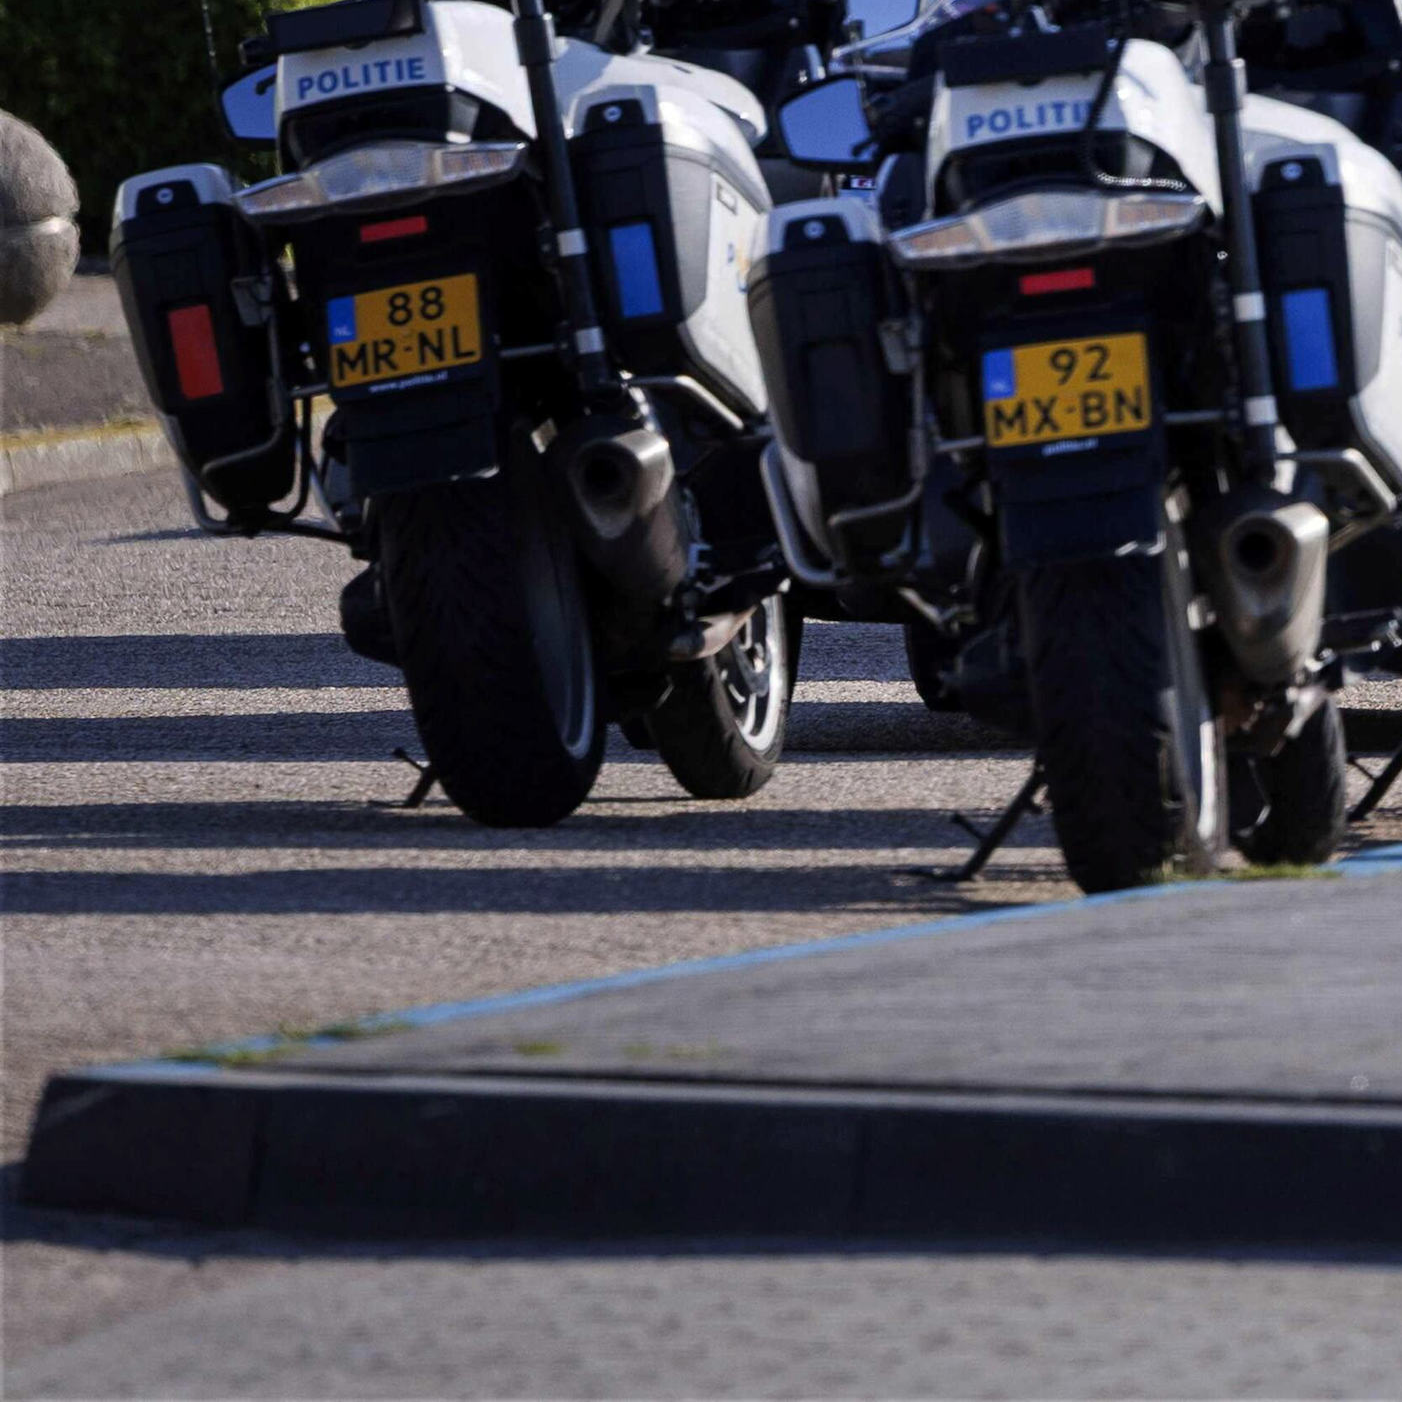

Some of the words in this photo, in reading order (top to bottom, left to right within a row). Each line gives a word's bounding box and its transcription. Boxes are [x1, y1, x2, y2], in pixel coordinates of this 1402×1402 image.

[297, 57, 426, 100] POLITIE
[388, 286, 445, 326] 88
[335, 326, 476, 381] MR-NL
[1050, 344, 1113, 386] 92
[993, 385, 1143, 439] MX-BN
